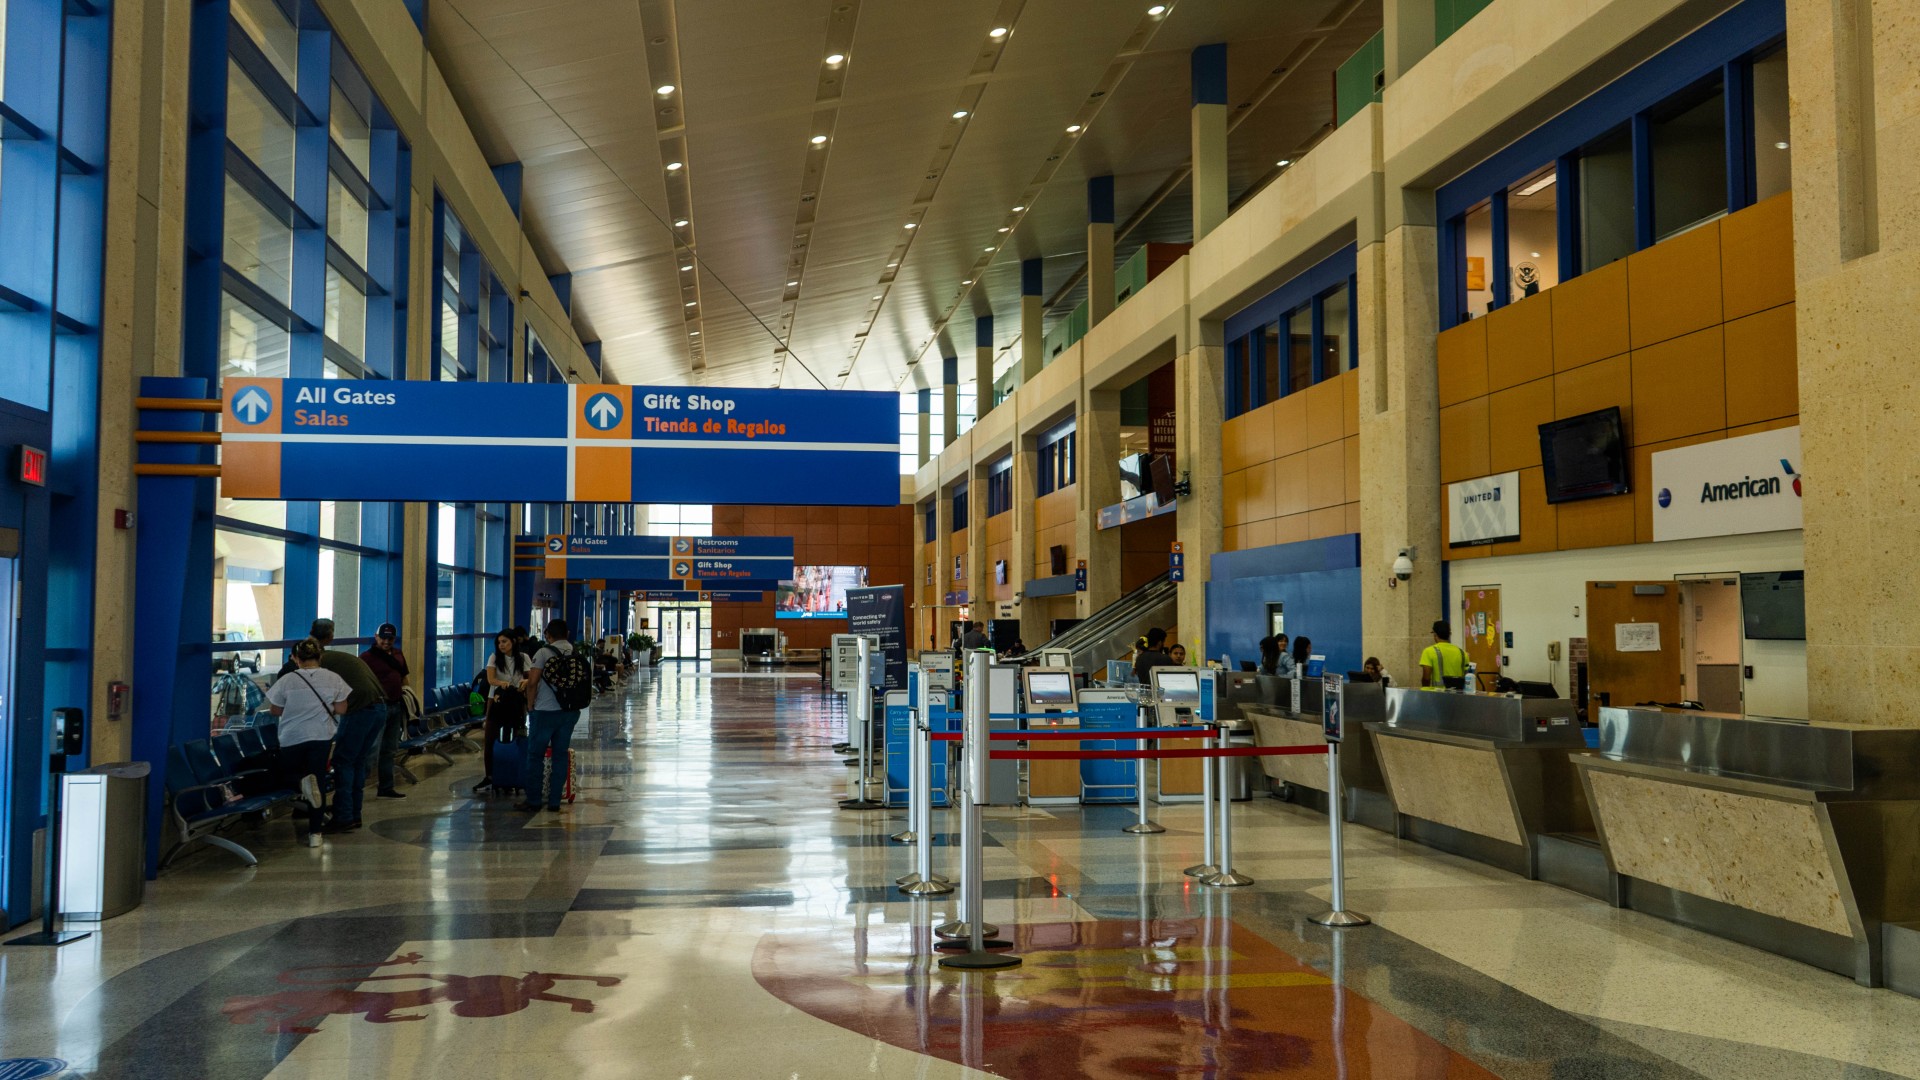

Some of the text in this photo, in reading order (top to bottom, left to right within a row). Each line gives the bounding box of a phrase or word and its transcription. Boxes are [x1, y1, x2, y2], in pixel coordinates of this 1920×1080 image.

[295, 386, 396, 406] All Gates
[643, 393, 736, 415] Gift Shop
[294, 409, 349, 427] Salas
[643, 416, 787, 438] Tienda de Regalos
[23, 449, 45, 483] EXIT
[1463, 492, 1493, 504] UNITED
[1700, 475, 1781, 503] American
[571, 537, 608, 545] All Gates
[697, 538, 739, 546] Restrooms
[697, 546, 736, 554] Sanitarios
[697, 561, 732, 570] Gift Shop
